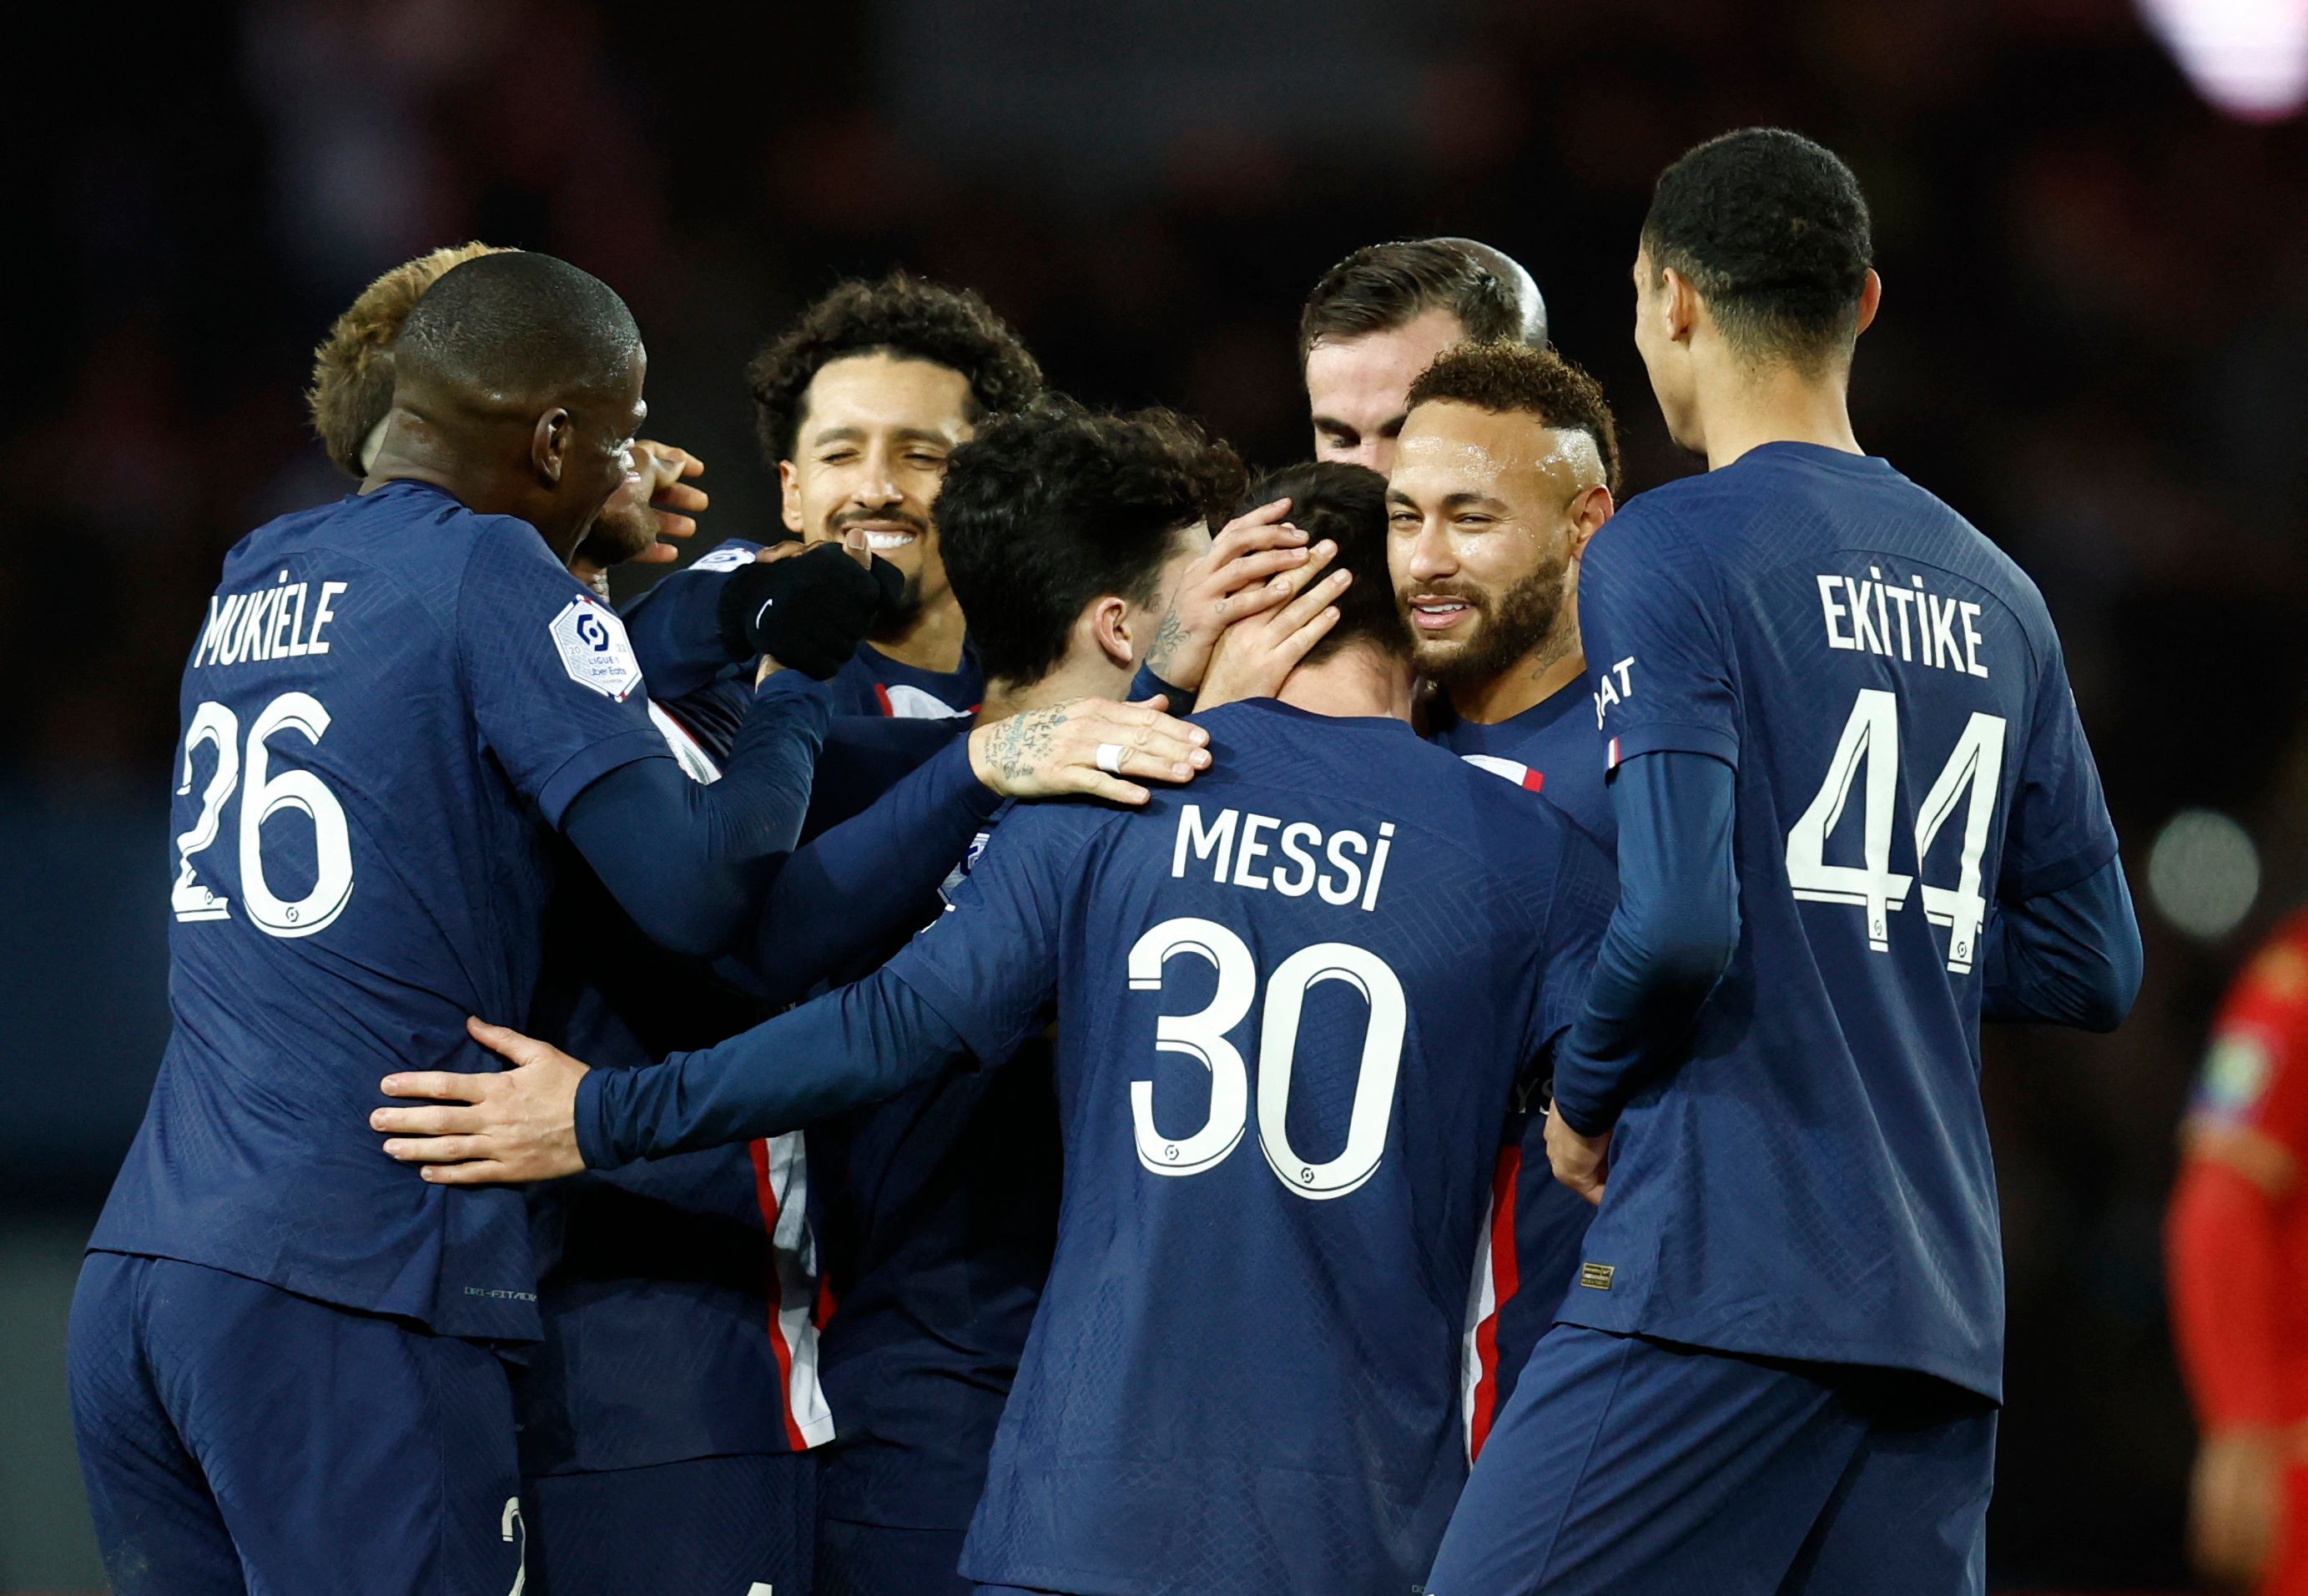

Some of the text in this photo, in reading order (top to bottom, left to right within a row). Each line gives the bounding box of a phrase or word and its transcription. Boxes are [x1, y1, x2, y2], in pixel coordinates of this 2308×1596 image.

[588, 656, 614, 665] LIGUE
[608, 667, 627, 676] Eats
[170, 691, 355, 939] 26
[1785, 688, 2007, 974] 44
[1127, 917, 1407, 1201] 30
